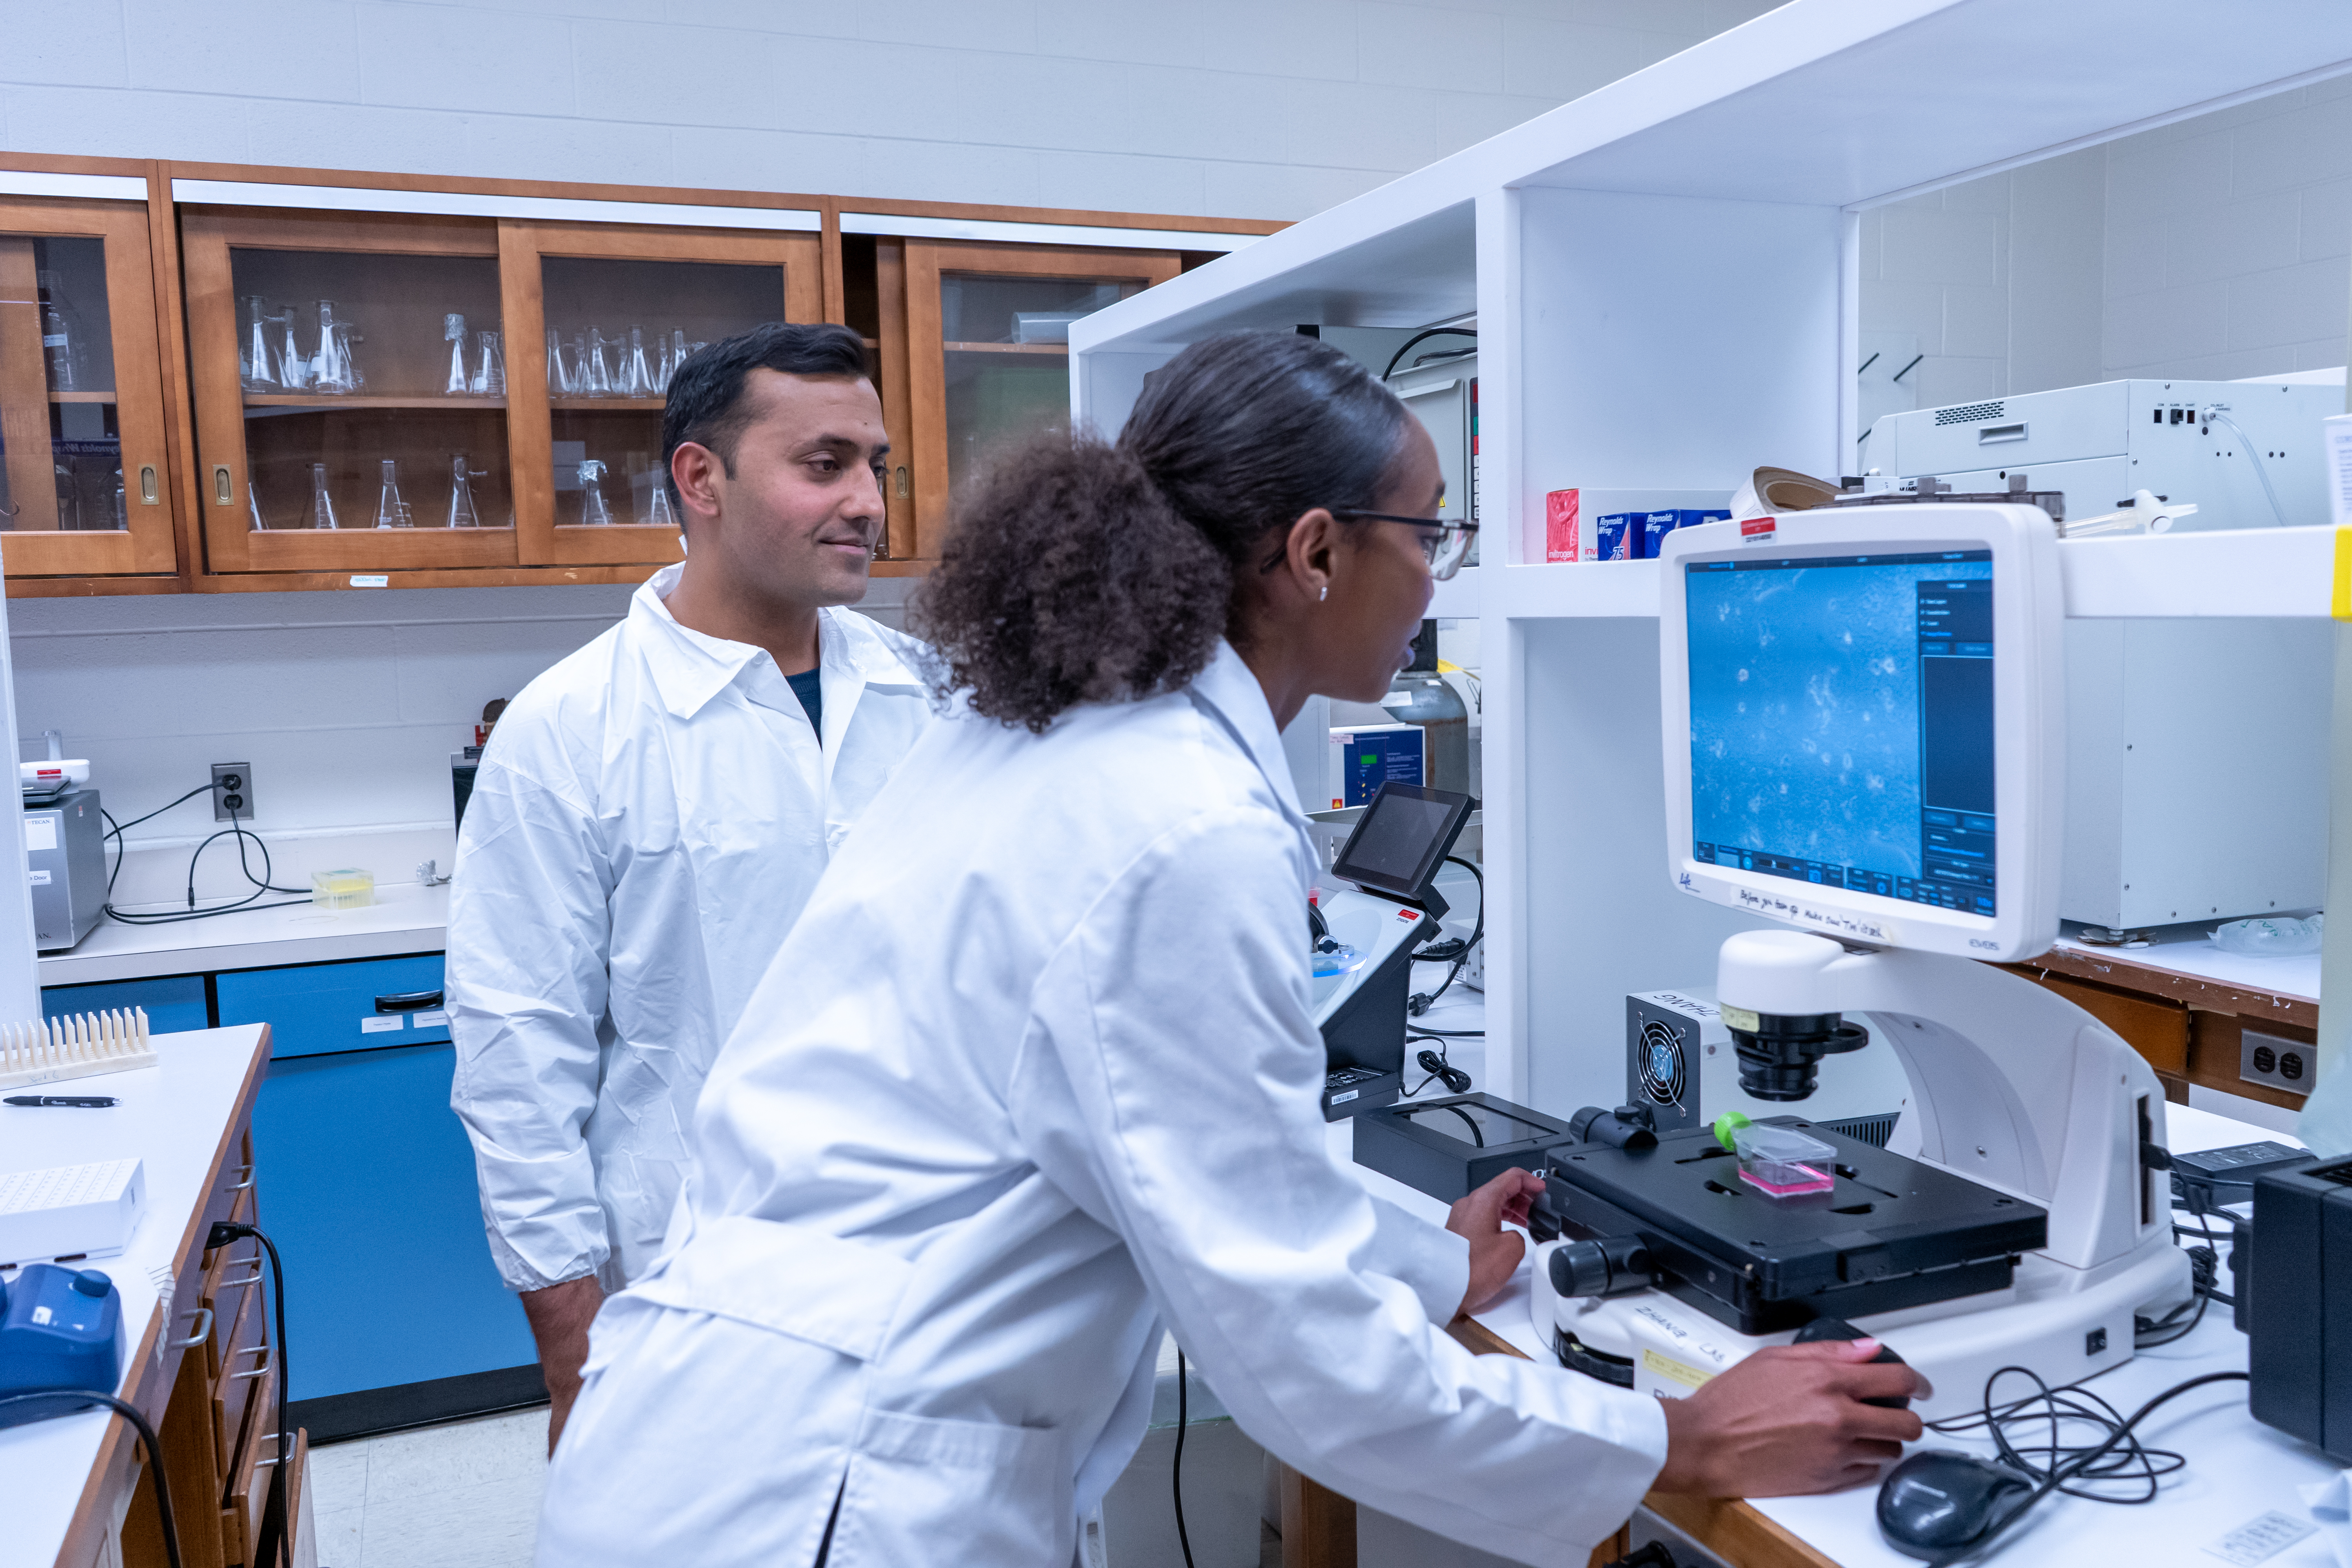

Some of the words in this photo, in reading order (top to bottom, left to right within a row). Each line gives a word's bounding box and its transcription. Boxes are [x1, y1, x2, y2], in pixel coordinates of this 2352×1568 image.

[1599, 516, 1624, 527] Reynolds
[1646, 514, 1673, 524] Reynolds
[1598, 526, 1613, 536] Wrap
[1645, 523, 1661, 534] Wrap
[1548, 550, 1573, 560] invitrogen
[1612, 546, 1624, 561] 75
[1740, 889, 1759, 906] Before
[1653, 995, 1720, 1016] ZHANG
[1635, 1306, 1688, 1338] ZHANG
